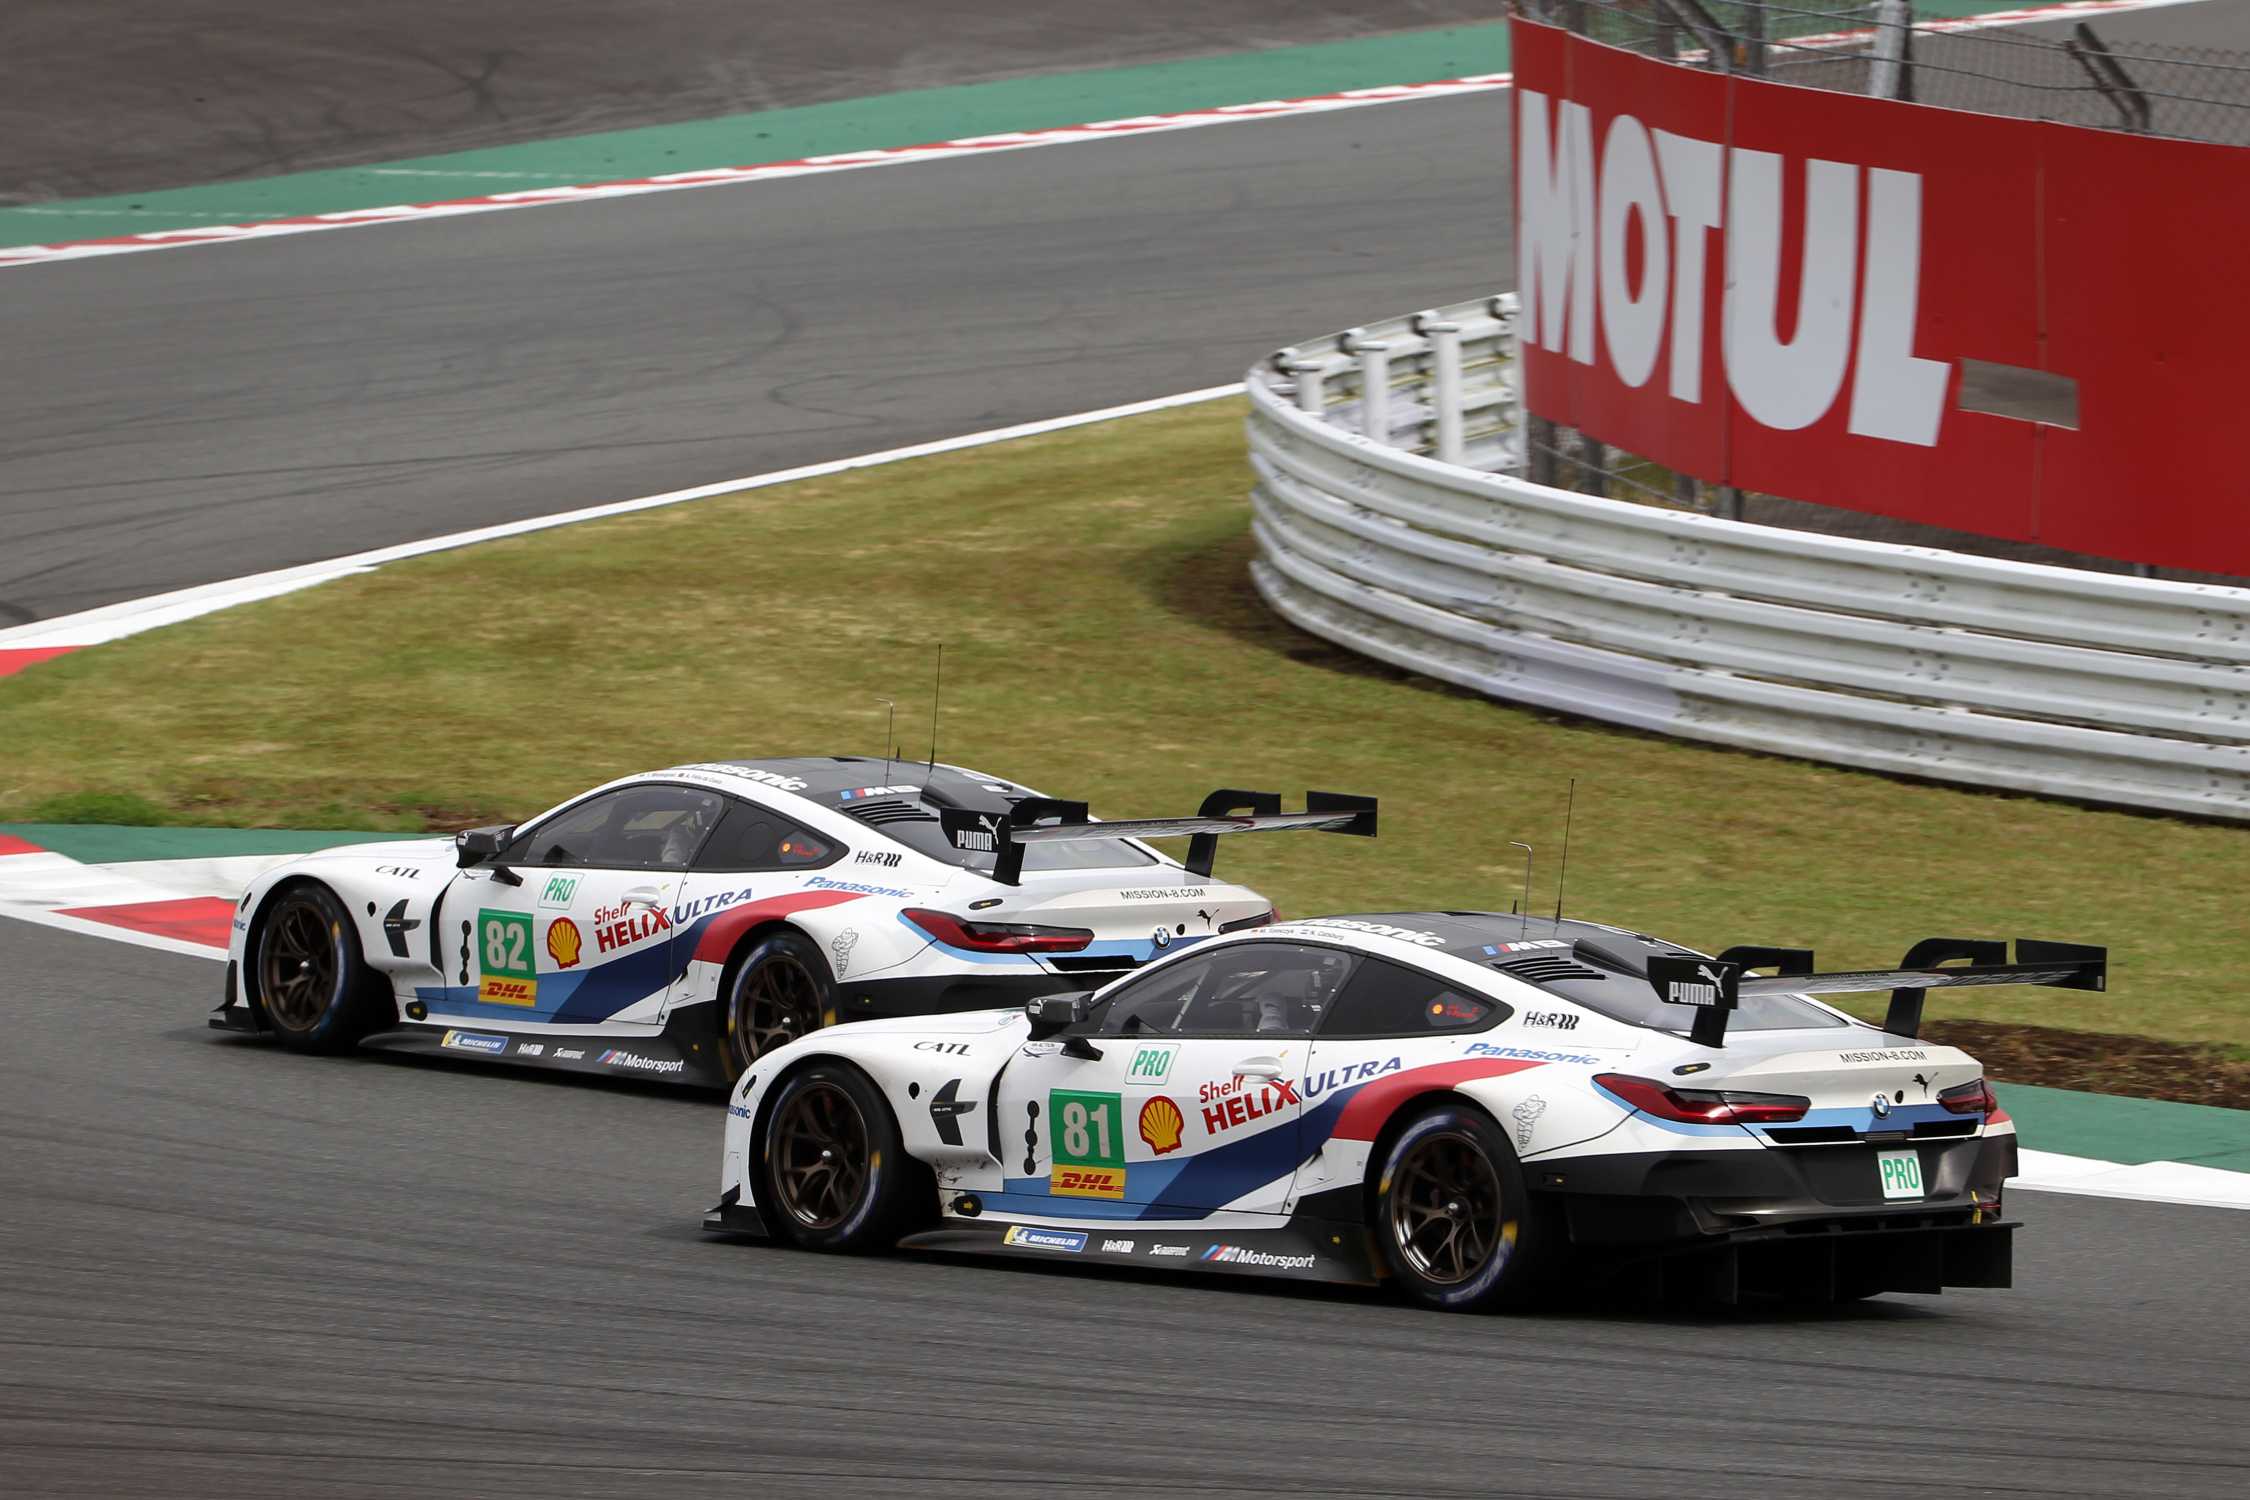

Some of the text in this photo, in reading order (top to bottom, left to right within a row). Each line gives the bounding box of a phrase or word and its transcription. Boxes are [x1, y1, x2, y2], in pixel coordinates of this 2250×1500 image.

[1519, 89, 1951, 447] MOTUL
[957, 830, 992, 851] PUMA
[375, 865, 422, 879] CATL
[544, 877, 576, 902] PRO
[803, 876, 915, 899] Panasonic
[1120, 887, 1206, 900] MISSION-8.COM
[593, 901, 631, 925] Shell
[595, 887, 752, 953] HELIX ULTRA
[485, 920, 528, 971] 82
[487, 982, 528, 999] DHL
[1668, 981, 1716, 1006] PUMA
[460, 1037, 502, 1049] MICHELIN
[913, 1041, 972, 1057] CATL
[1464, 1043, 1601, 1066] Panasonic
[624, 1054, 685, 1074] Motorsport
[1131, 1050, 1170, 1077] PRO
[1199, 1075, 1245, 1103] Shell
[1200, 1056, 1402, 1135] HELIX ULTRA
[1063, 1101, 1111, 1159] 81
[1059, 1172, 1116, 1192] DHL
[1881, 1156, 1922, 1191] PRO
[1029, 1235, 1079, 1247] MICHELIN
[1236, 1249, 1316, 1269] Motorsport
